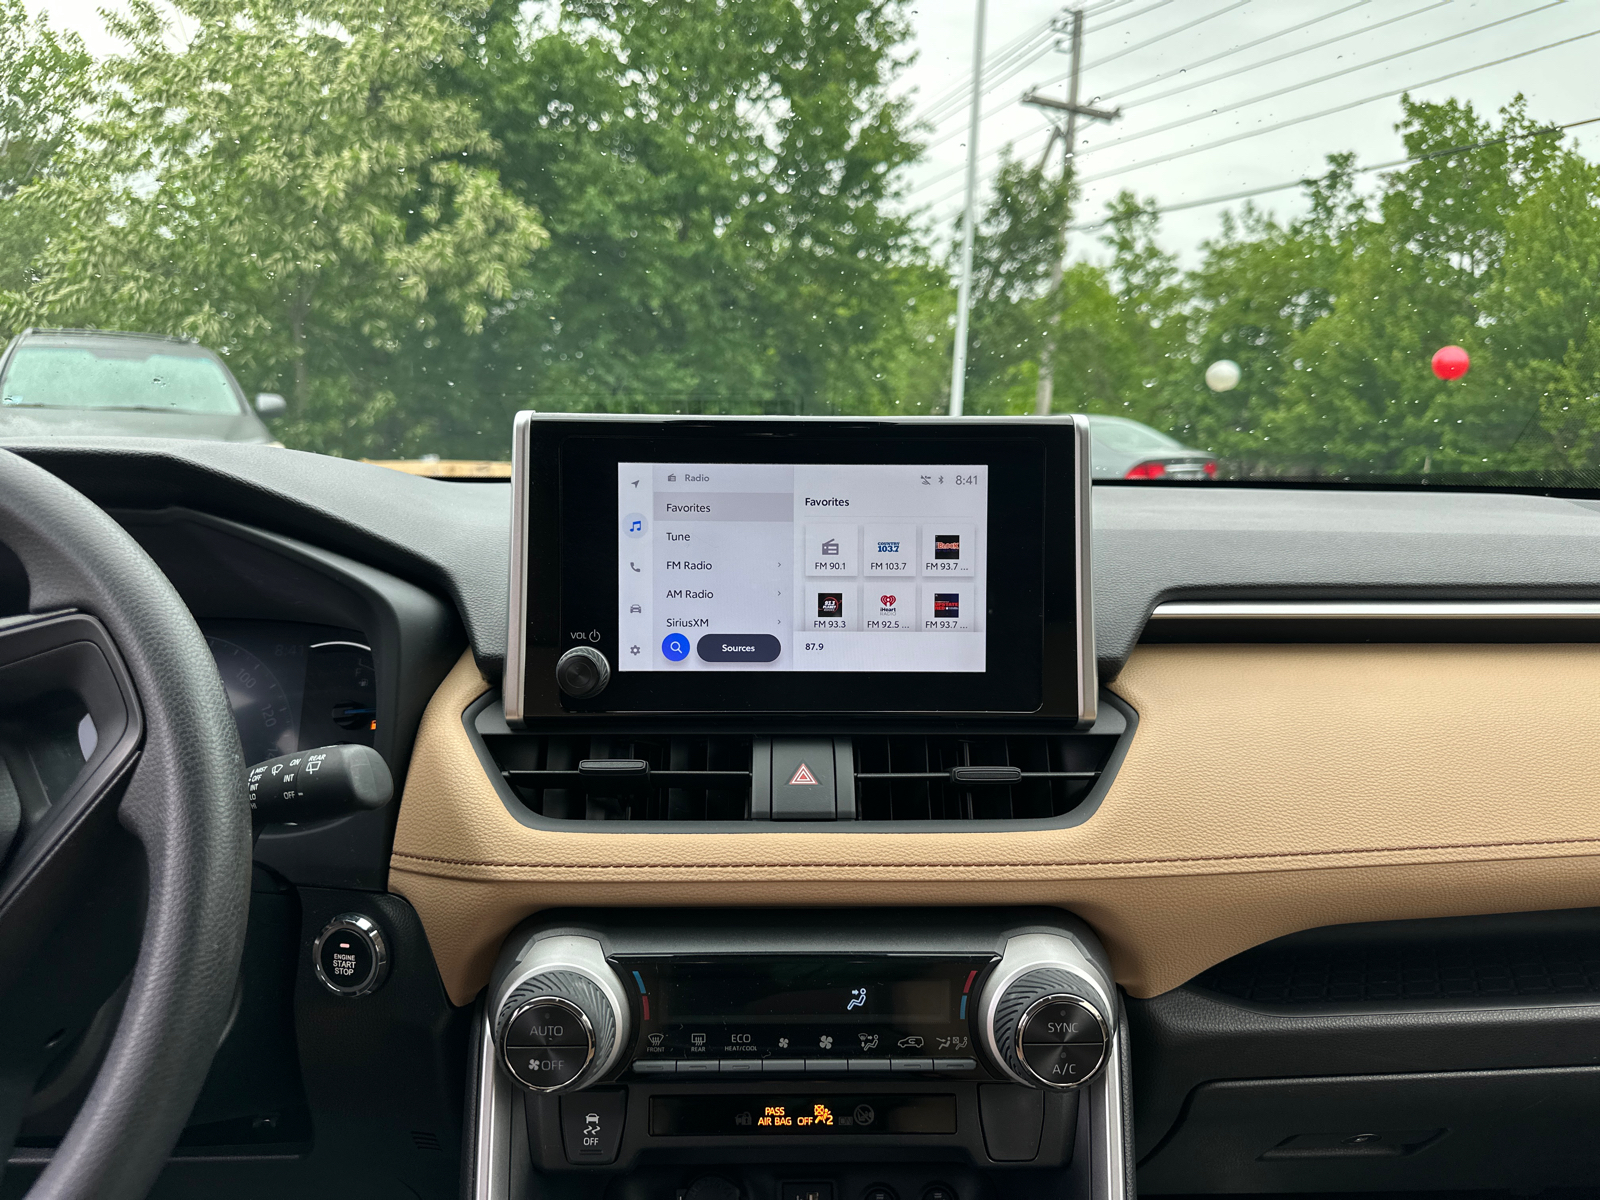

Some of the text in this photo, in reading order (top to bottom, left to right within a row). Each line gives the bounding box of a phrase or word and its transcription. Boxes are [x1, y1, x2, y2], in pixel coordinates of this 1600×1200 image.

[684, 474, 710, 482] Radio
[955, 475, 978, 485] 8:41
[805, 498, 850, 507] Favorites
[666, 503, 711, 513] Favorites
[666, 532, 691, 541] Tune
[666, 561, 713, 570] FM Radio
[885, 562, 907, 570] 103.7
[940, 562, 958, 570] 93.7
[666, 590, 714, 599] AM Radio
[666, 618, 709, 628] SiriusXM
[722, 644, 756, 652] Sources
[236, 668, 257, 688] 100
[261, 703, 277, 727] 120
[289, 758, 302, 766] ON
[252, 774, 262, 782] OFF
[283, 774, 295, 782] INT
[283, 791, 296, 800] OFF
[333, 960, 356, 968] START
[335, 968, 354, 976] STOP
[530, 1025, 564, 1036] AUTO
[1048, 1022, 1079, 1033] SYNC
[731, 1034, 751, 1043] ECO
[541, 1060, 564, 1071] OFF
[1052, 1063, 1077, 1075] A/C
[765, 1107, 785, 1116] PASS
[758, 1117, 813, 1126] AIR BAG OFF
[583, 1137, 599, 1146] OFF
